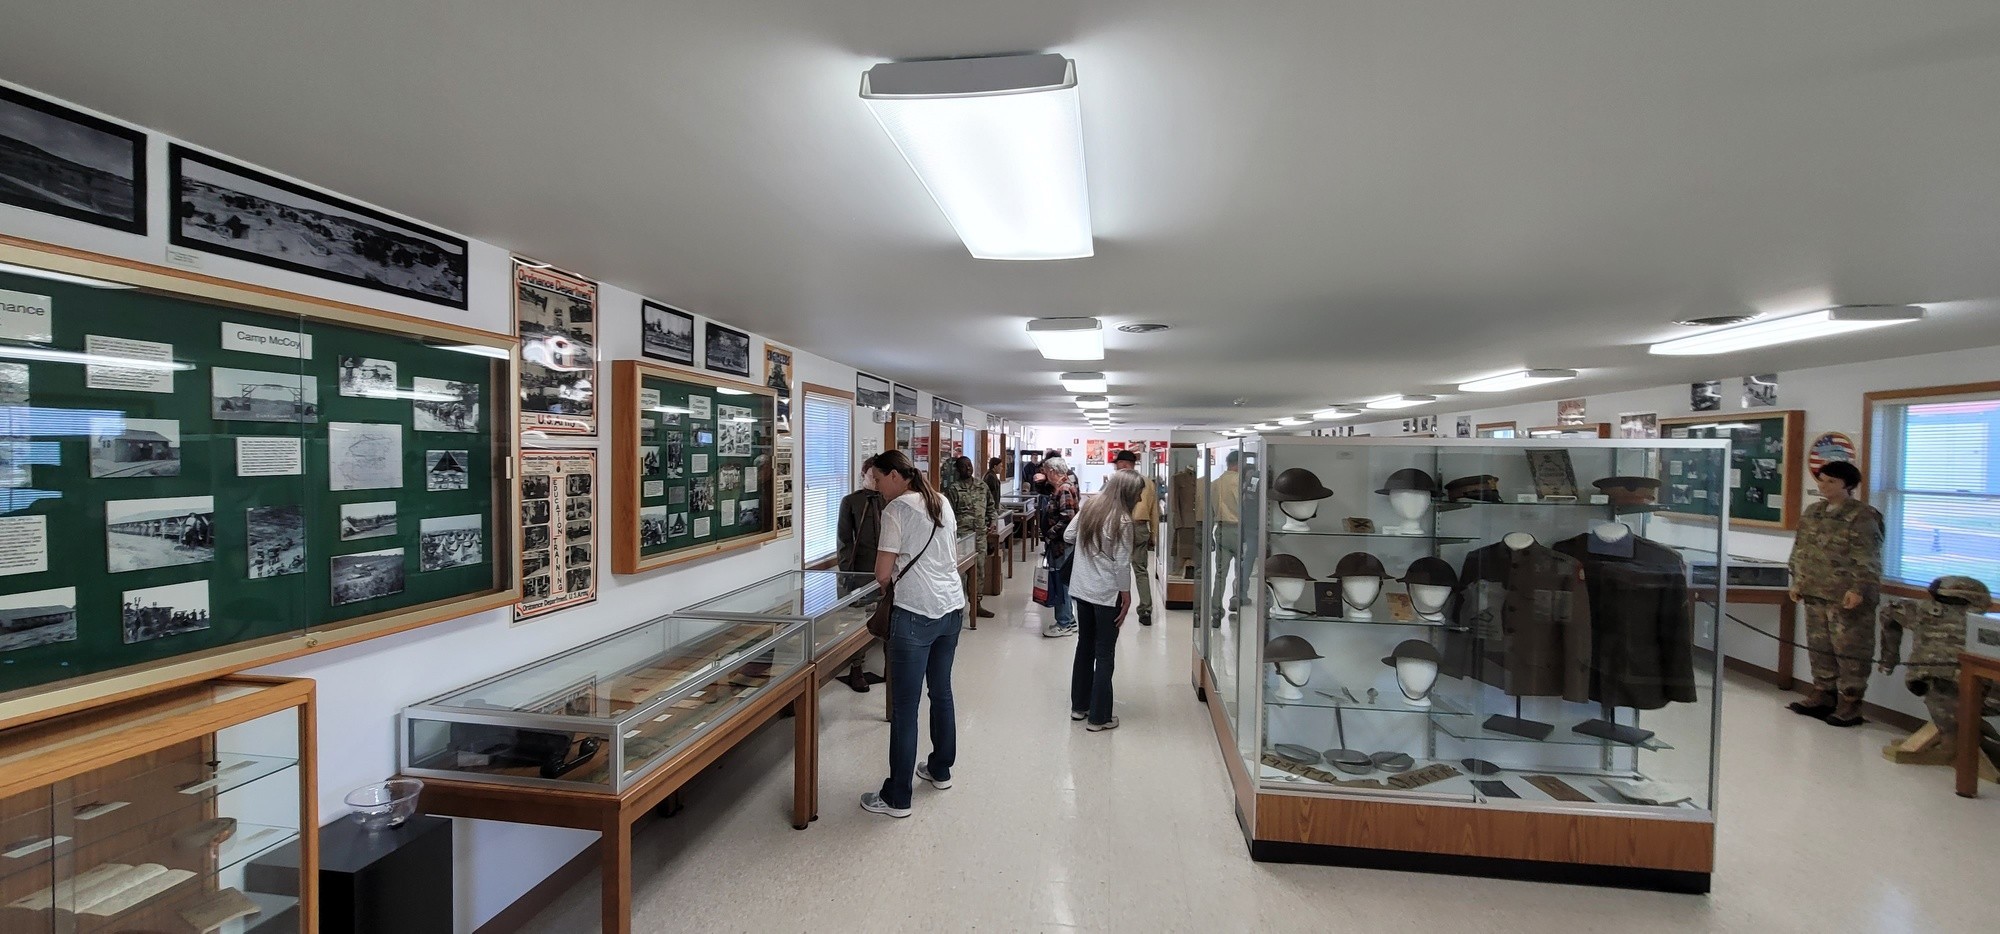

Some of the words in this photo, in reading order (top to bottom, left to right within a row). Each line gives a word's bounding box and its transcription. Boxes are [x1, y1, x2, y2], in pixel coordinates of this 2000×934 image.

[237, 331, 266, 344] Camp
[269, 336, 301, 349] McCoy
[553, 480, 562, 535] EDUCATION
[553, 538, 562, 591] TRAINING
